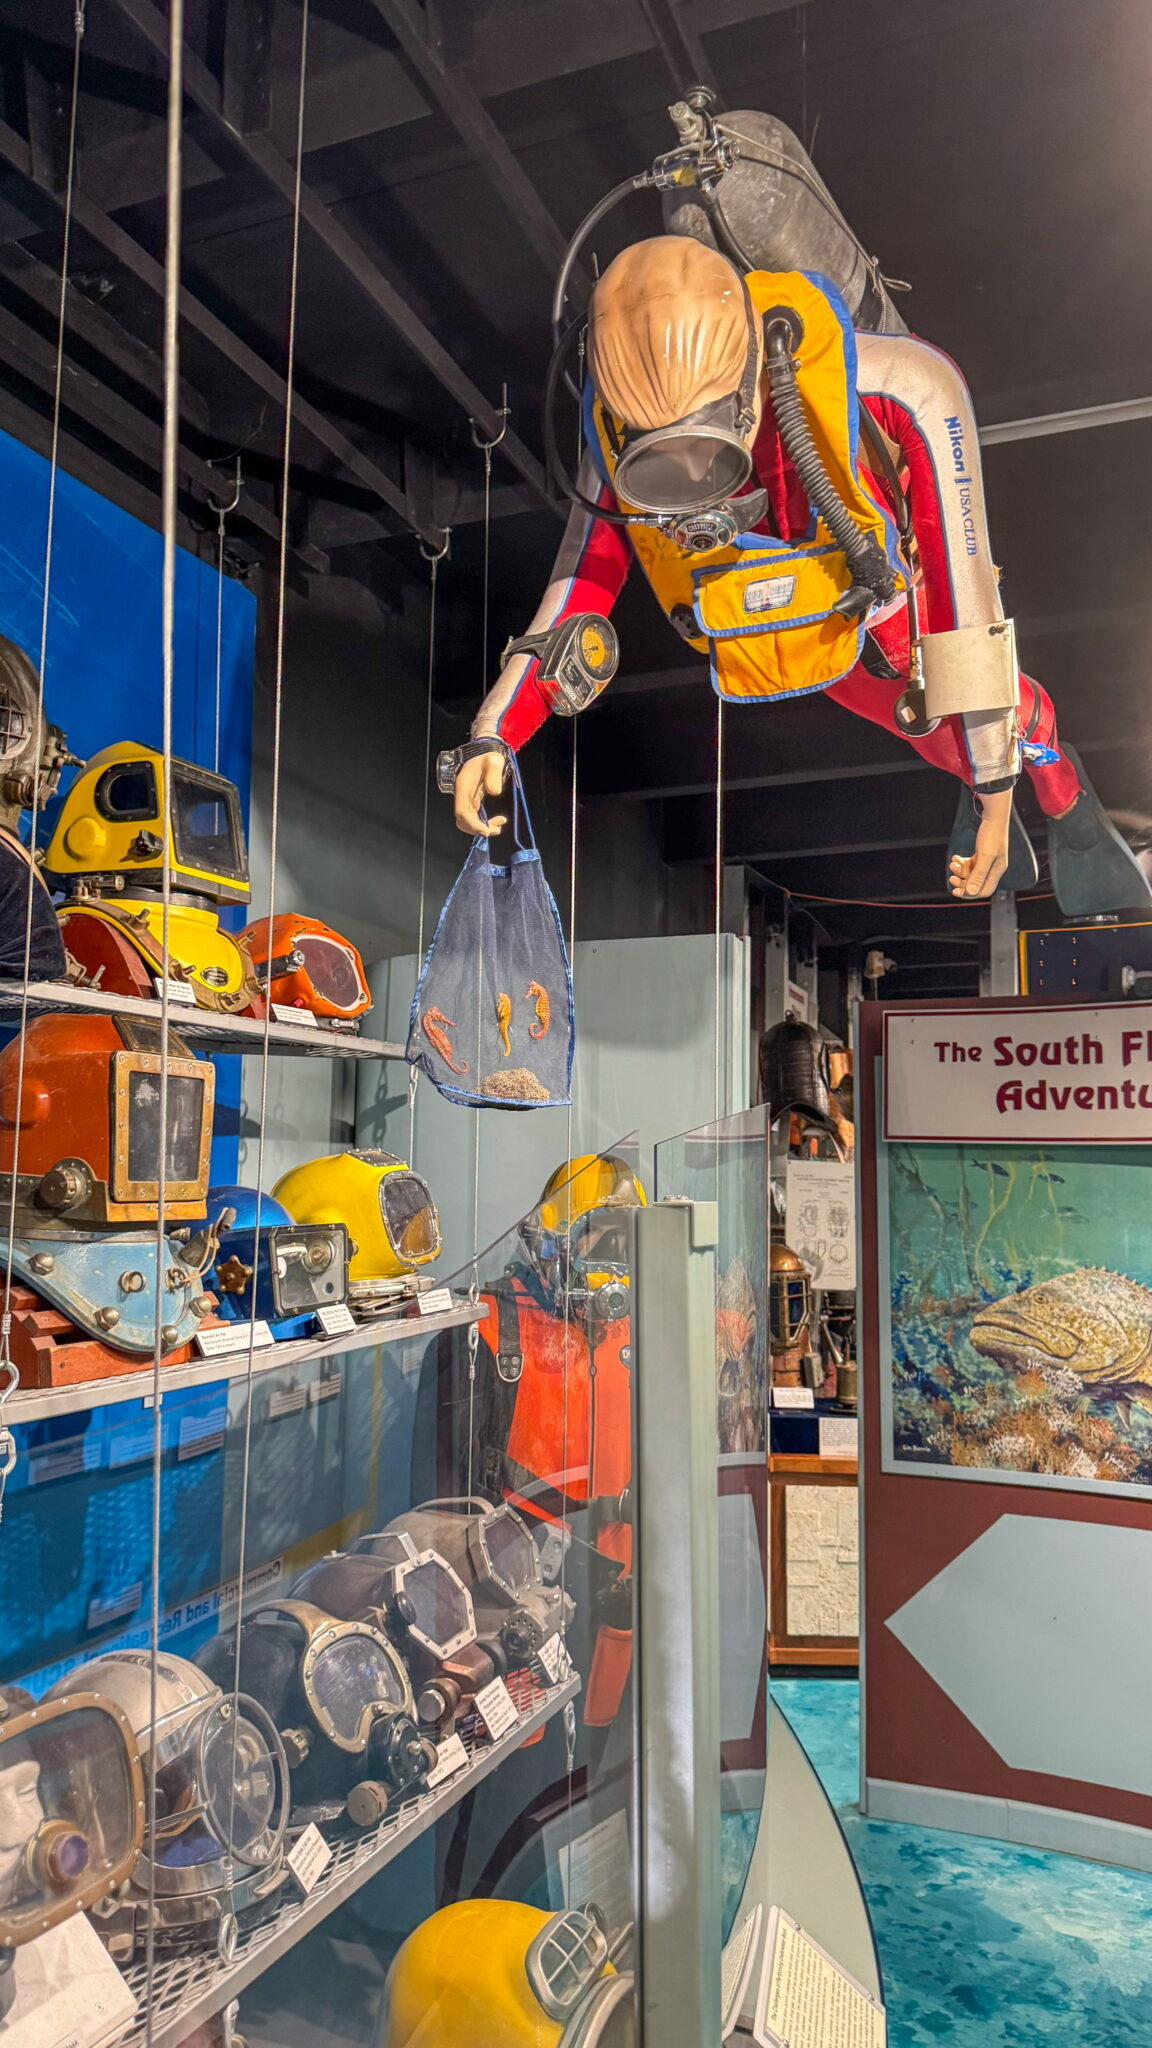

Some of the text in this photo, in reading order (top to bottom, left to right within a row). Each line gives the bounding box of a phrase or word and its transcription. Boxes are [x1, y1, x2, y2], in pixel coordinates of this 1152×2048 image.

[944, 416, 978, 557] Nikon USA CLUB
[934, 1042, 982, 1063] The
[993, 1033, 1104, 1066] South
